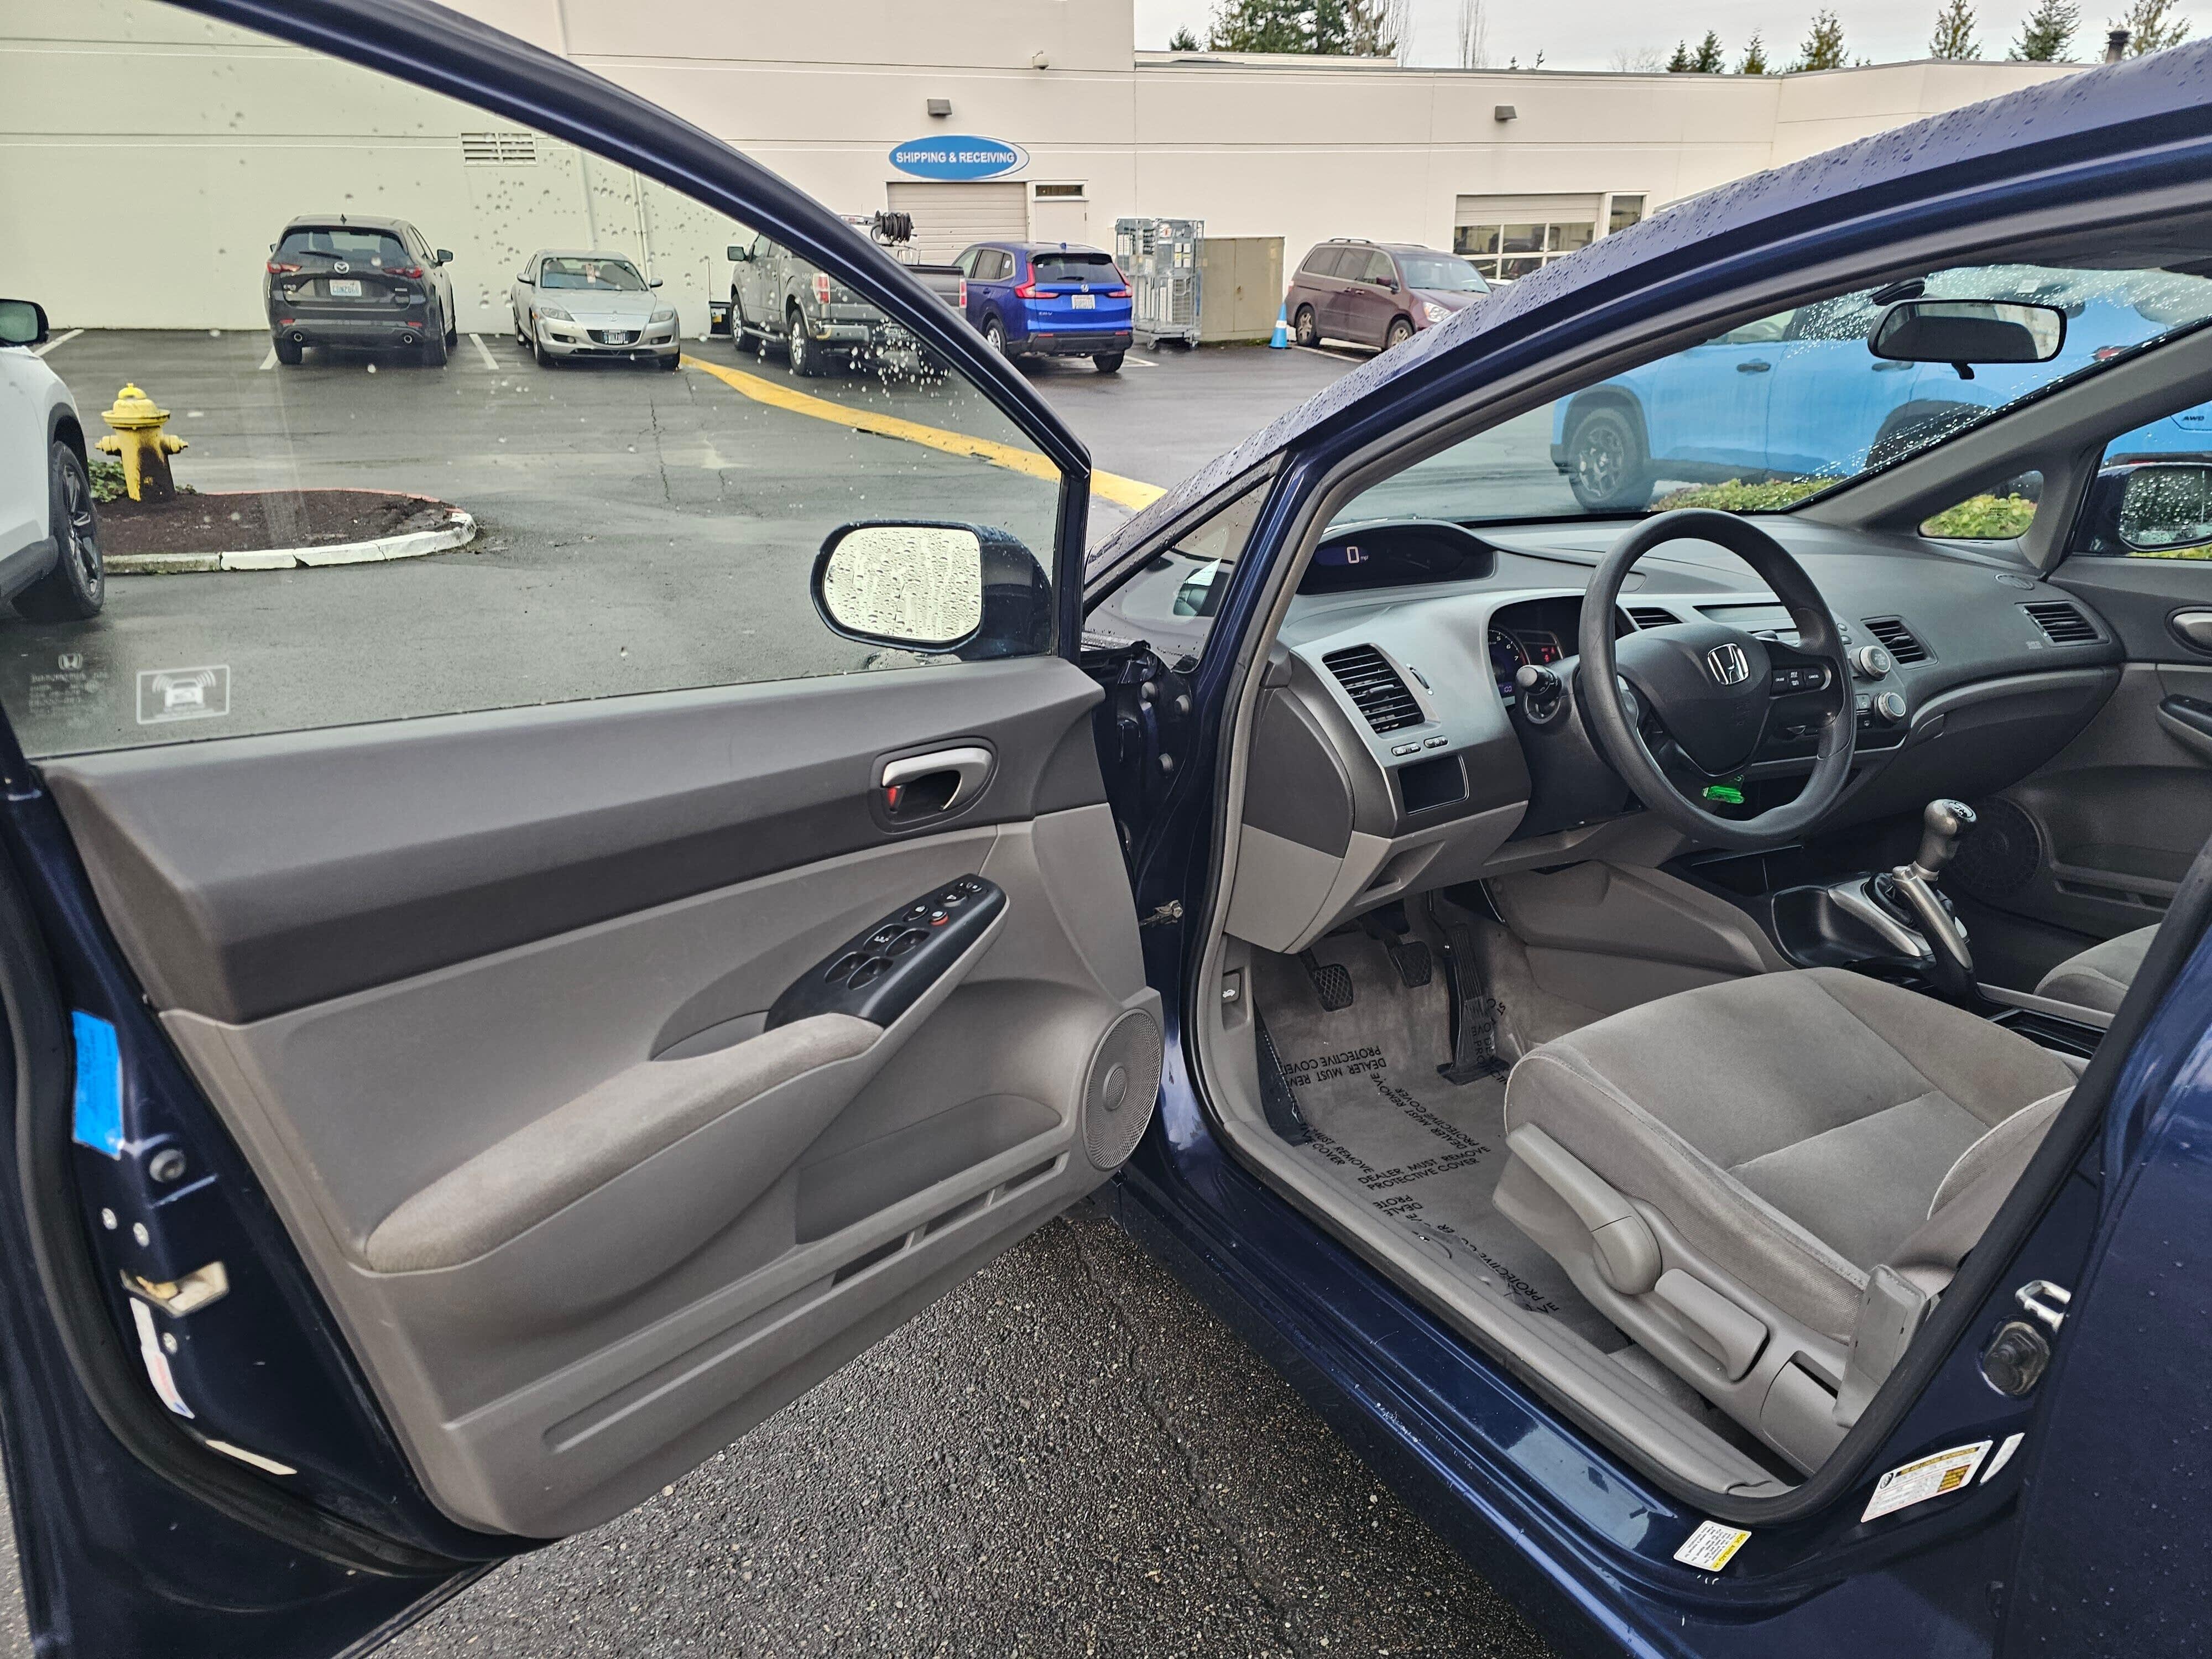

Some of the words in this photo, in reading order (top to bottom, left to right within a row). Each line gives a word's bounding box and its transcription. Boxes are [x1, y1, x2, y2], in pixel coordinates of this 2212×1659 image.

[896, 152, 947, 163] SHIPPING
[948, 152, 957, 163] &
[958, 152, 1015, 163] RECEIVING
[1347, 546, 1359, 564] 0
[1319, 1045, 1381, 1067] PROTECTIVE
[1348, 1058, 1387, 1074] DEALER
[1287, 1074, 1311, 1087] REM
[1317, 1067, 1343, 1082] MUST
[1370, 1073, 1407, 1107] REMOVE
[1395, 1088, 1427, 1113] COVER
[1404, 1109, 1432, 1126] MUST
[1424, 1113, 1480, 1146] PROTECTIVE
[1431, 1128, 1468, 1150] DEALER
[1312, 1143, 1345, 1166] COVER
[1334, 1146, 1375, 1173] REMOVE
[1358, 1168, 1405, 1184] DEALER
[1406, 1159, 1438, 1172] MUST
[1441, 1146, 1491, 1162] REMOVE
[1366, 1167, 1438, 1190] PROTECTIVE
[1438, 1157, 1480, 1172] COVER
